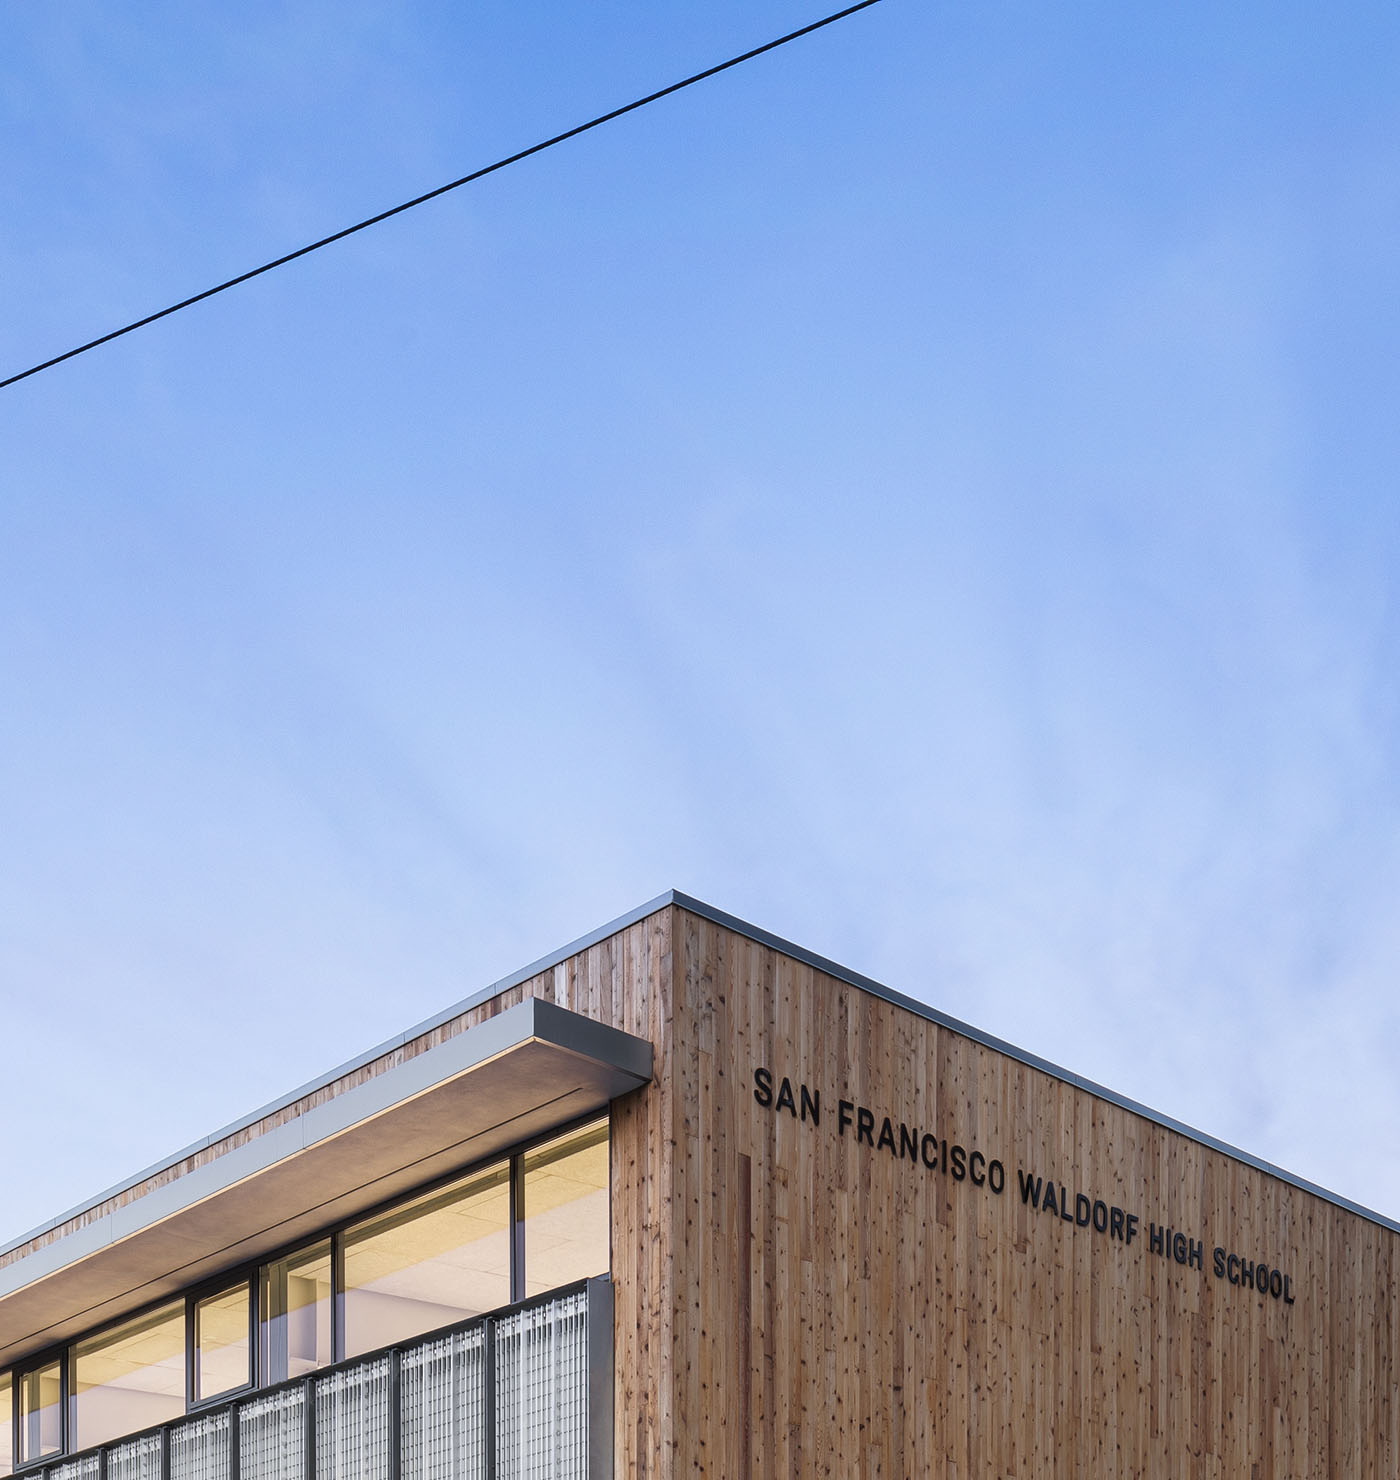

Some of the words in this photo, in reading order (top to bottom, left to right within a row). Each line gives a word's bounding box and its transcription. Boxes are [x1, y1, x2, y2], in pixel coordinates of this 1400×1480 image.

[753, 1067, 820, 1126] SAN
[838, 1099, 1005, 1195] FRANCISCO
[1018, 1169, 1139, 1245] WALDORF
[1150, 1222, 1204, 1271] HIGH
[1213, 1247, 1296, 1305] SCHOOL
